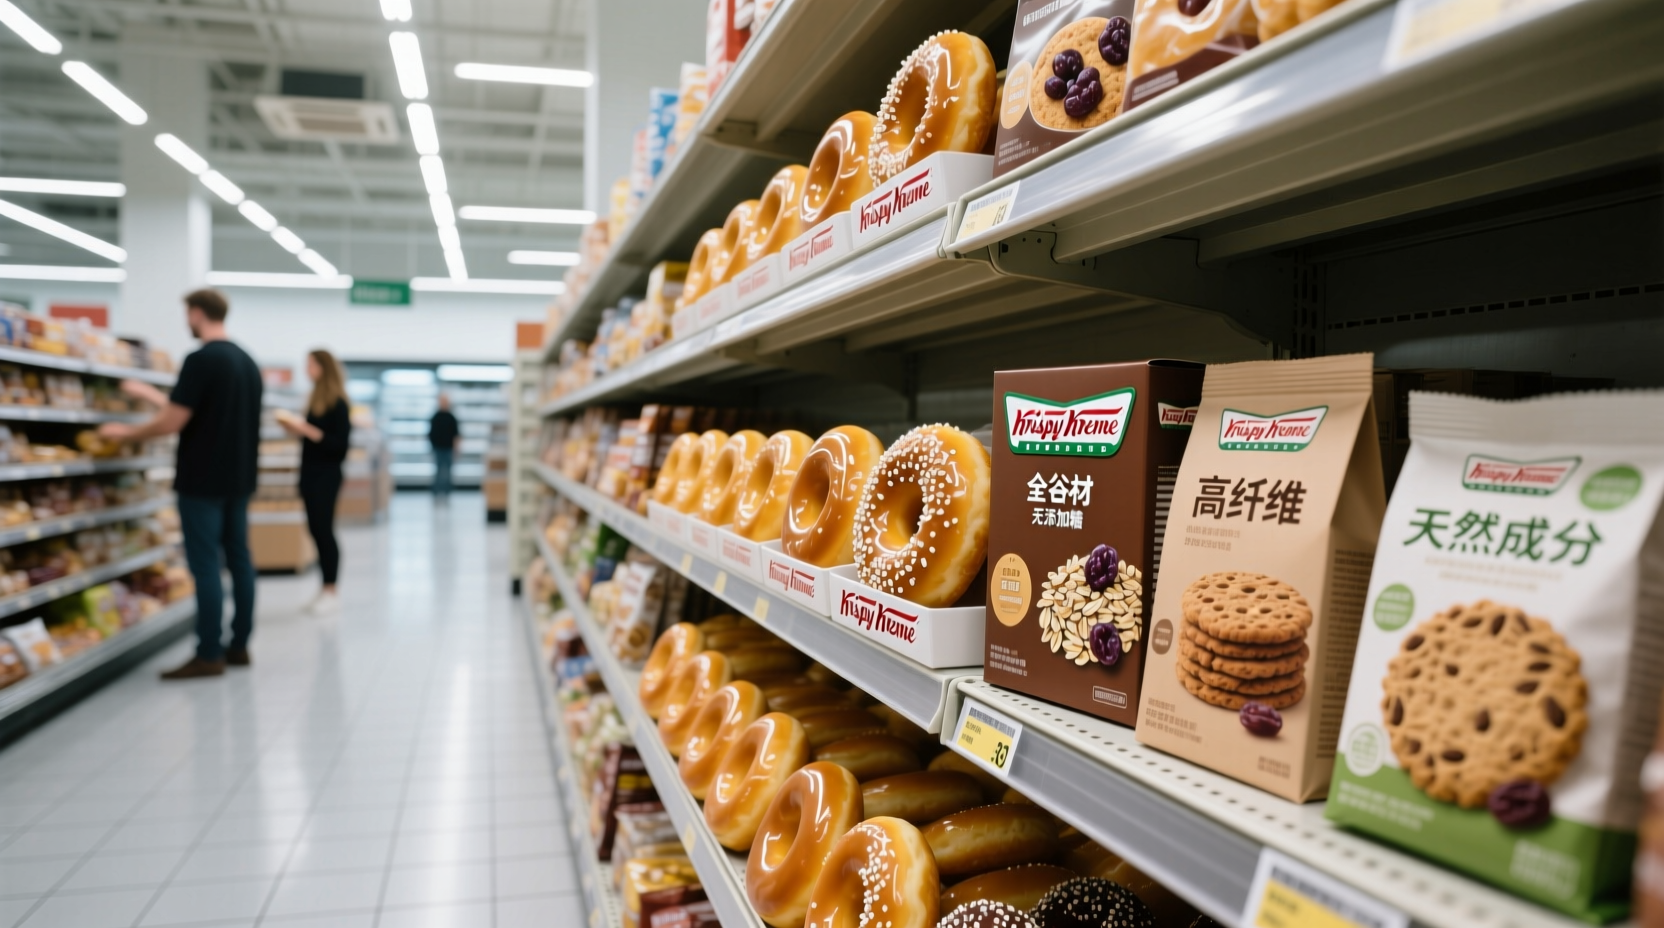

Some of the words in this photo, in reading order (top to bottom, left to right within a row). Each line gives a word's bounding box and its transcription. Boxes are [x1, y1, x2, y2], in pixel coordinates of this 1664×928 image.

[1012, 409, 1067, 441] Krispy
[1063, 406, 1123, 437] Kreme
[1026, 471, 1094, 507] 全谷材
[1192, 474, 1307, 525] 高纤维
[1403, 508, 1602, 565] 天然成分
[840, 589, 877, 631] Krispy
